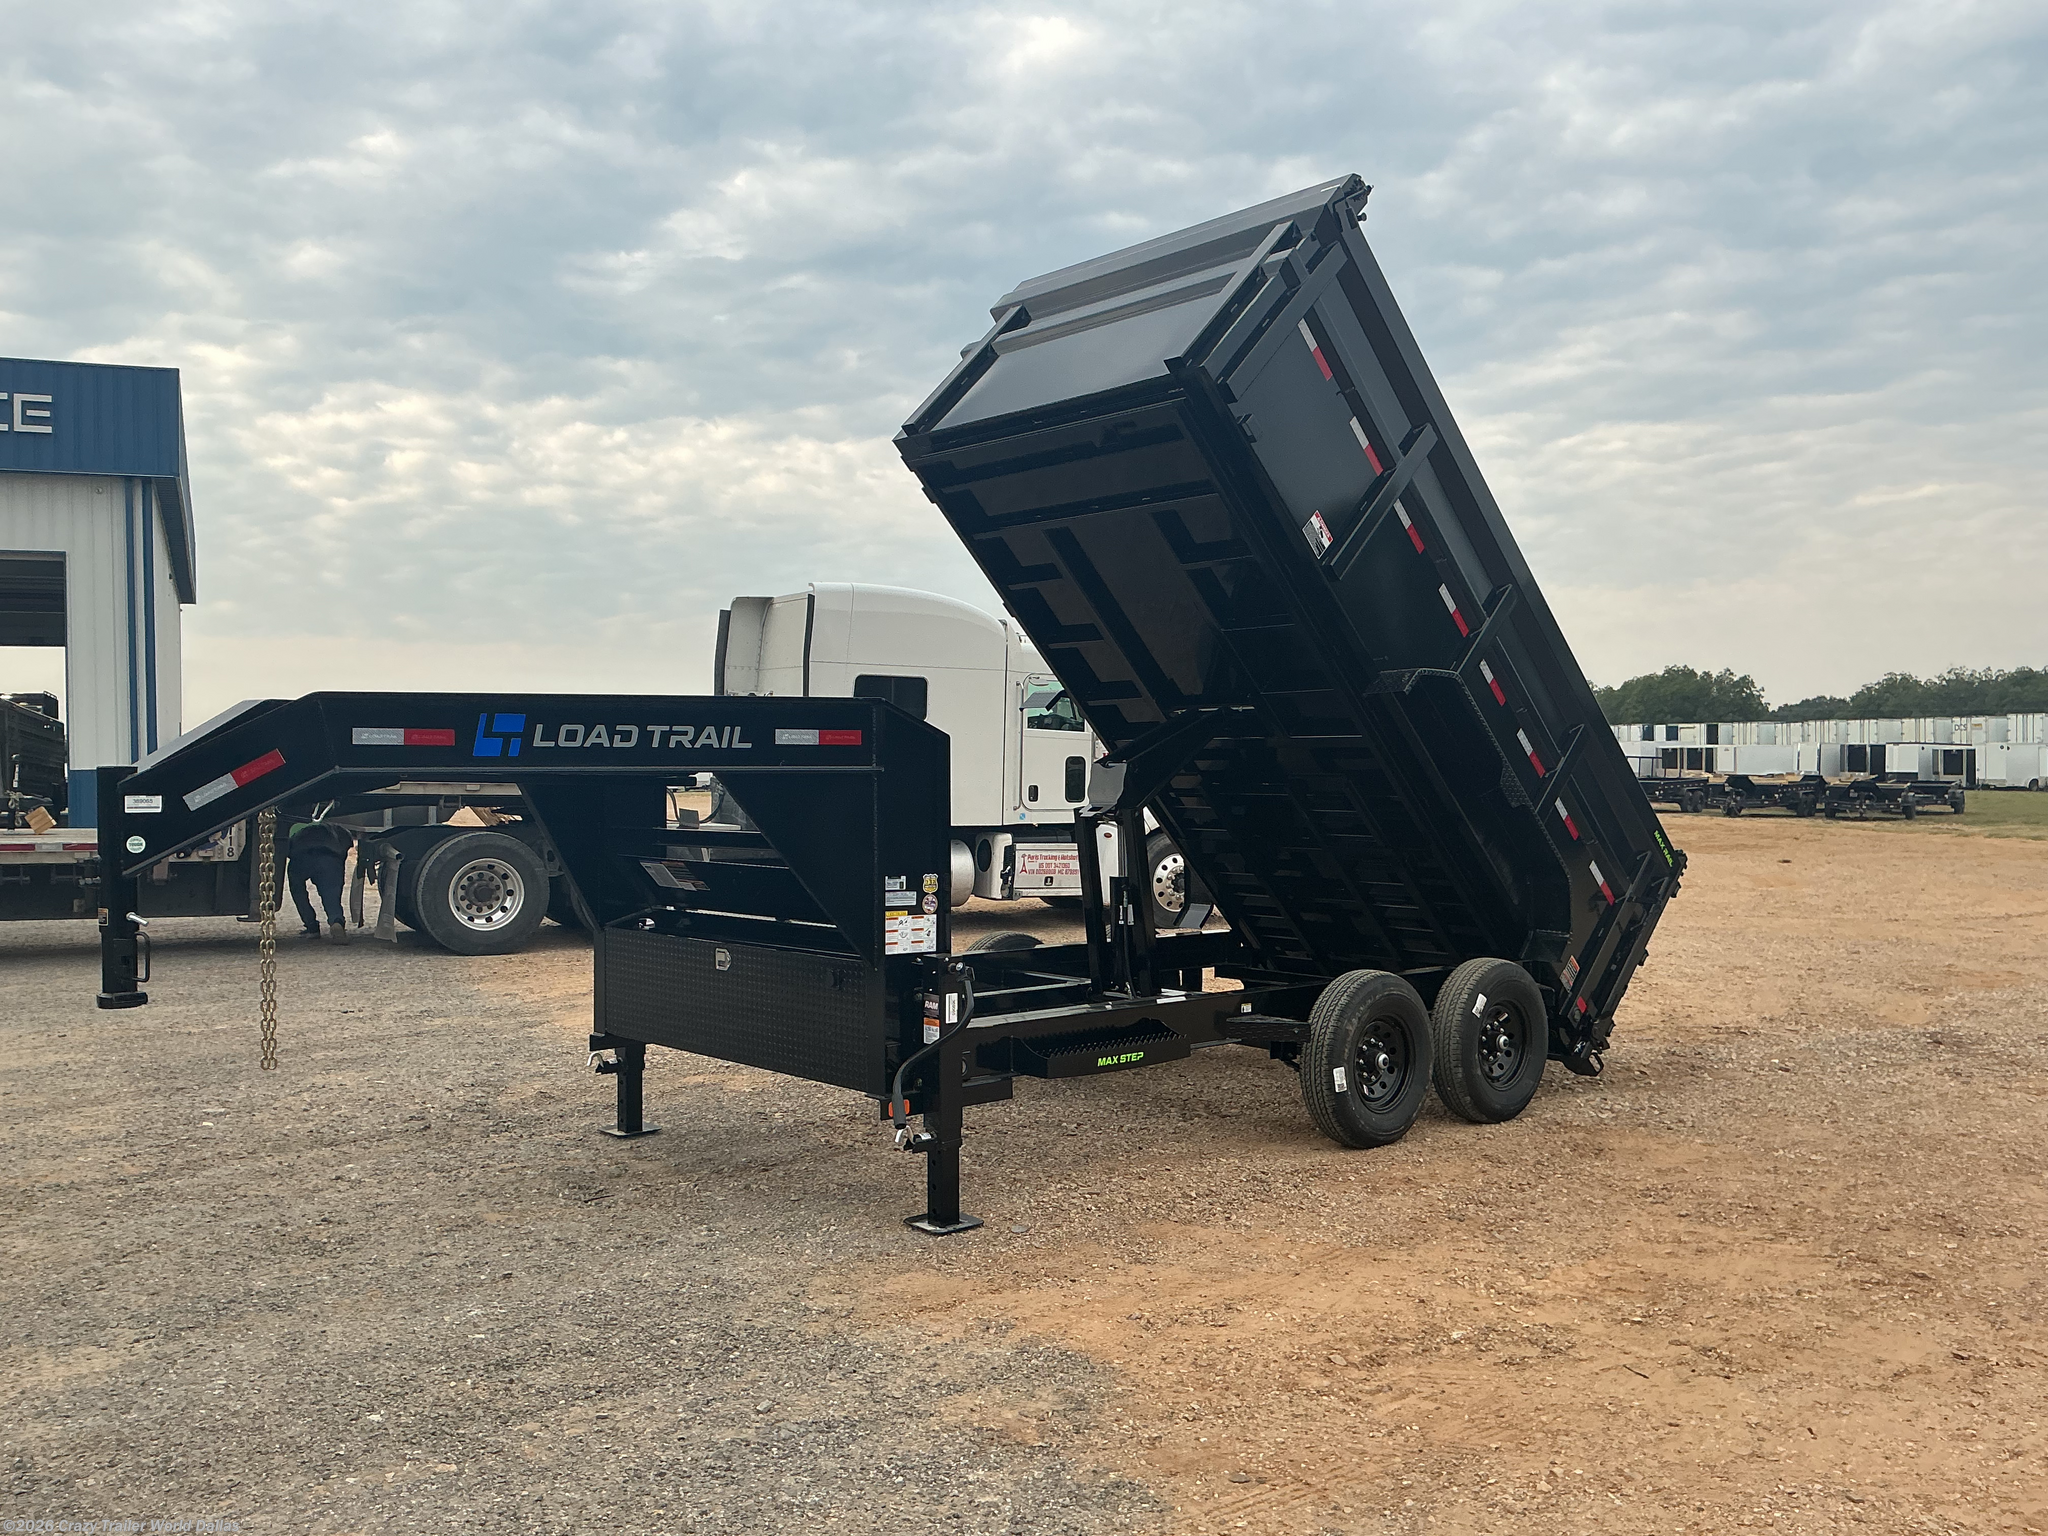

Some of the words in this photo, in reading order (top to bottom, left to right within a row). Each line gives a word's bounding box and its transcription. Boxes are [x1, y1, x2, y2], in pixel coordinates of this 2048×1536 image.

[0, 392, 53, 434] E
[533, 723, 640, 748] LOAD
[647, 725, 753, 749] TRAIL
[1653, 830, 1666, 850] MAX
[1663, 848, 1673, 868] RAIL
[924, 1000, 939, 1010] RAM
[1097, 1055, 1119, 1067] MAX
[1120, 1051, 1144, 1064] STEP
